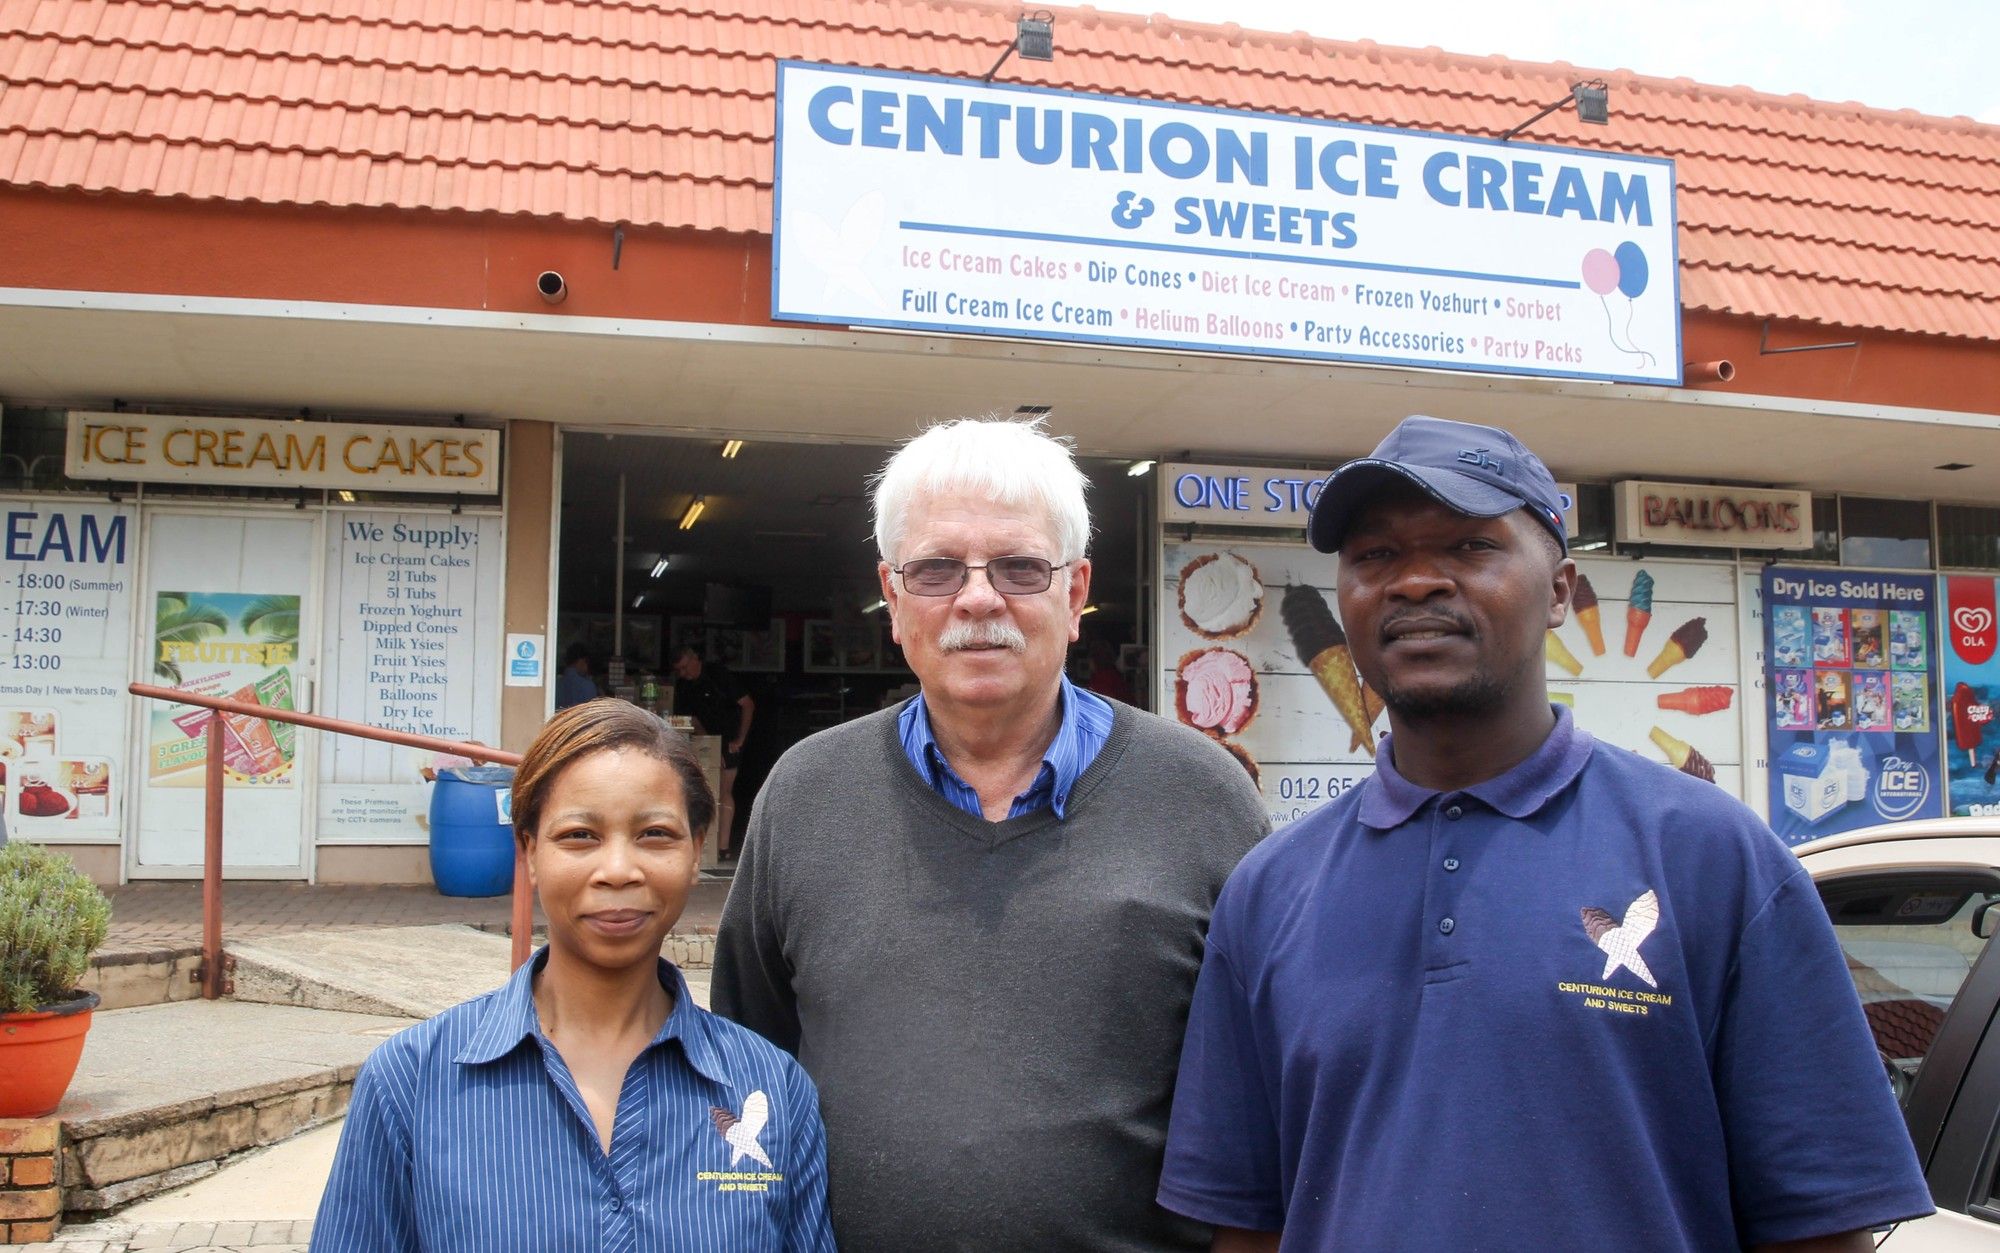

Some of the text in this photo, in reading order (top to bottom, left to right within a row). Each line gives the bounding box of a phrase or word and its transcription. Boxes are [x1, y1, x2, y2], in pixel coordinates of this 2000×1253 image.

[808, 85, 1653, 227] CENTURION ICE CREAM
[1111, 190, 1358, 249] & SWEETS
[902, 245, 1562, 321] Ice Cream Cakes Dip Cones Diet Ice Cream Frozen Yoghurt Sorbet
[902, 289, 1583, 364] Full Cream Ice Cream Helium Balloons Party Accessories Party Packs
[83, 424, 485, 478] ICE CREAM CAKES
[1175, 473, 1250, 511] ONE
[1643, 495, 1800, 533] BALLOONS
[6, 511, 127, 564] EAM
[348, 522, 479, 550] We Supply:
[355, 552, 470, 567] Ice Cream Cakes
[17, 573, 65, 590] 18:00
[69, 578, 123, 593] (Summer)
[405, 570, 437, 584] Tubs
[404, 587, 436, 600] Tubs
[1772, 577, 1805, 600] Dry
[1808, 579, 1837, 598] Ice
[1840, 581, 1879, 599] Sold
[1882, 583, 1925, 601] Here
[15, 600, 61, 617] 17:30
[66, 606, 109, 620] (Winter)
[359, 602, 462, 619] Frozen Yoghurt
[14, 627, 61, 643] 14:30
[363, 620, 458, 635] Dipped Cones
[376, 637, 444, 651] Milk Ysies
[1962, 637, 1986, 647] OLA
[12, 654, 61, 670] 13:00
[373, 654, 446, 668] Fruit Ysies
[370, 671, 449, 686] Party Packs
[25, 685, 42, 696] Day
[53, 686, 72, 695] New
[74, 686, 98, 696] Years
[101, 687, 117, 697] Day
[380, 688, 438, 701] Balloons
[383, 705, 433, 720] Dry Ice
[421, 723, 469, 736] More...
[1882, 756, 1914, 772] Dry
[1280, 777, 1368, 800] 012 65
[1880, 771, 1920, 790] ICE
[1558, 981, 1672, 1005] CENTURION ICE CREAM
[1584, 997, 1648, 1015] AND SWEETS
[696, 1171, 783, 1182] CENTURION ICE CREAM
[718, 1182, 769, 1192] AND SWEETS
